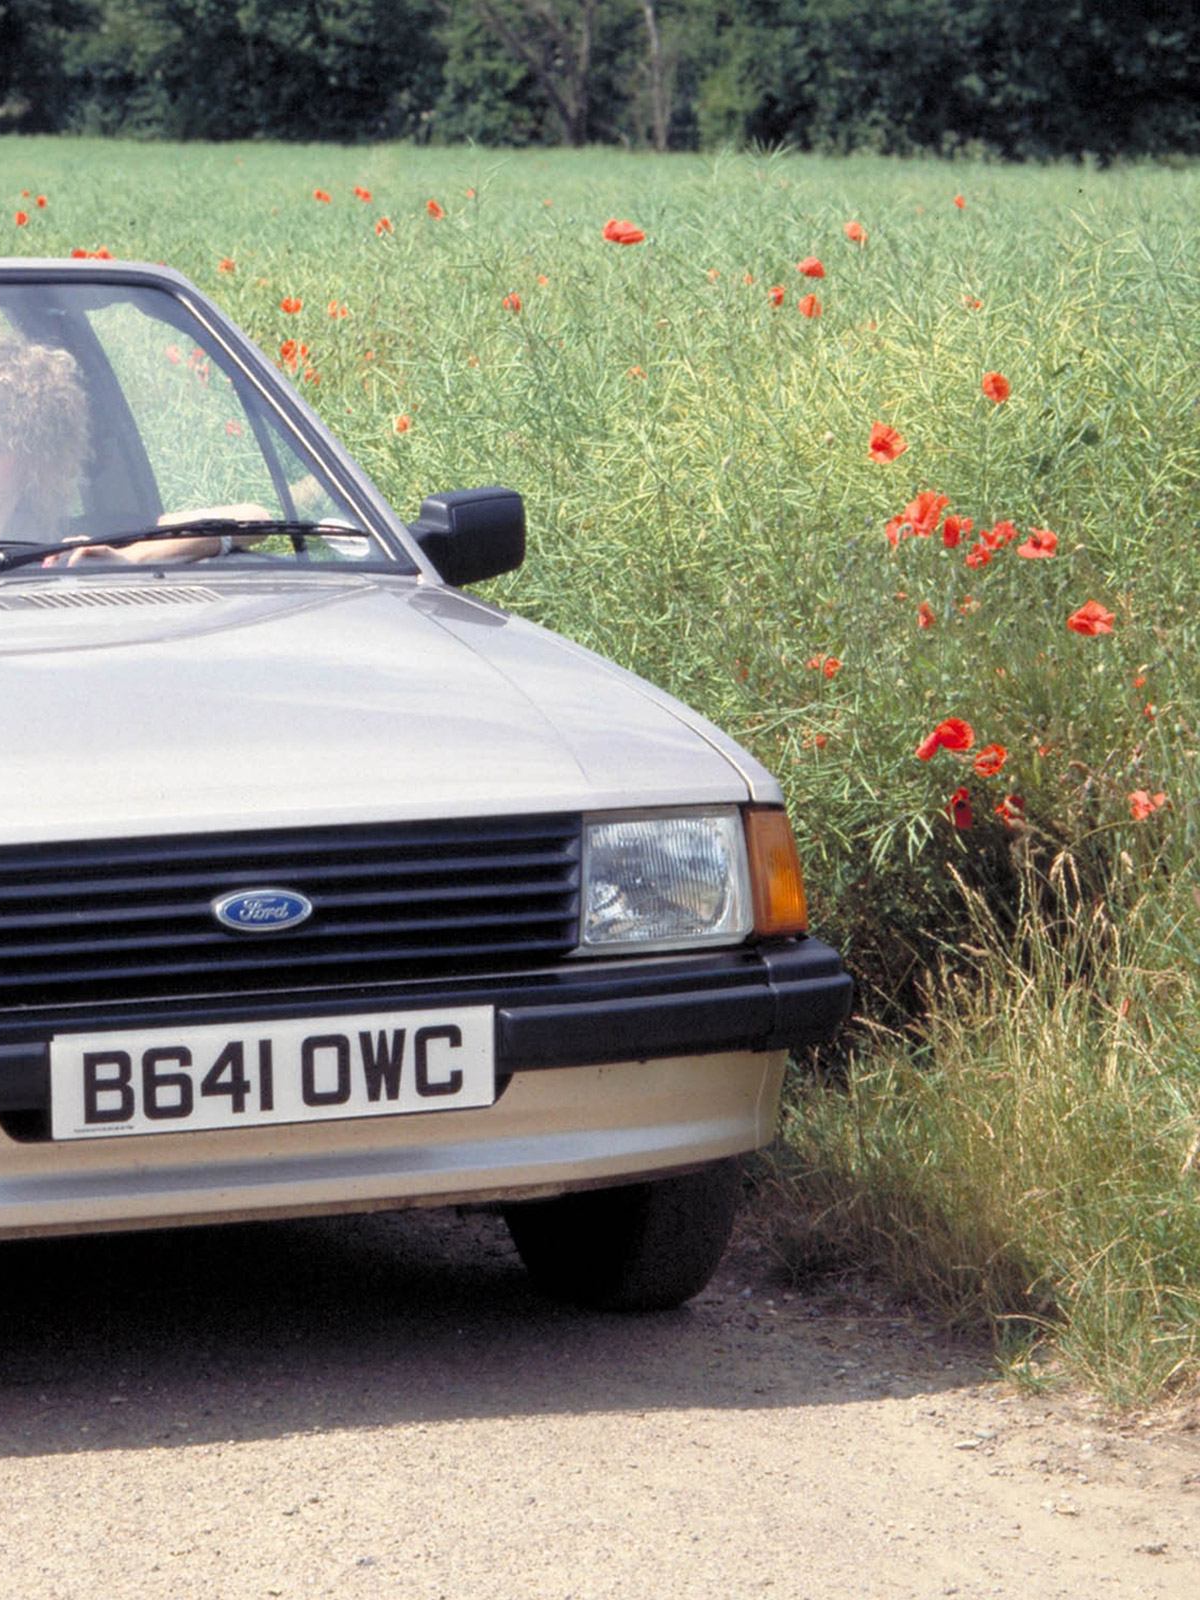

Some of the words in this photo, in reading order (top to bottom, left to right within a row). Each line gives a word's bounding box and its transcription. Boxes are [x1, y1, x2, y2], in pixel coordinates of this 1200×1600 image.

[239, 897, 289, 921] Ford
[83, 1039, 274, 1125] B641
[300, 1024, 463, 1107] OWC
